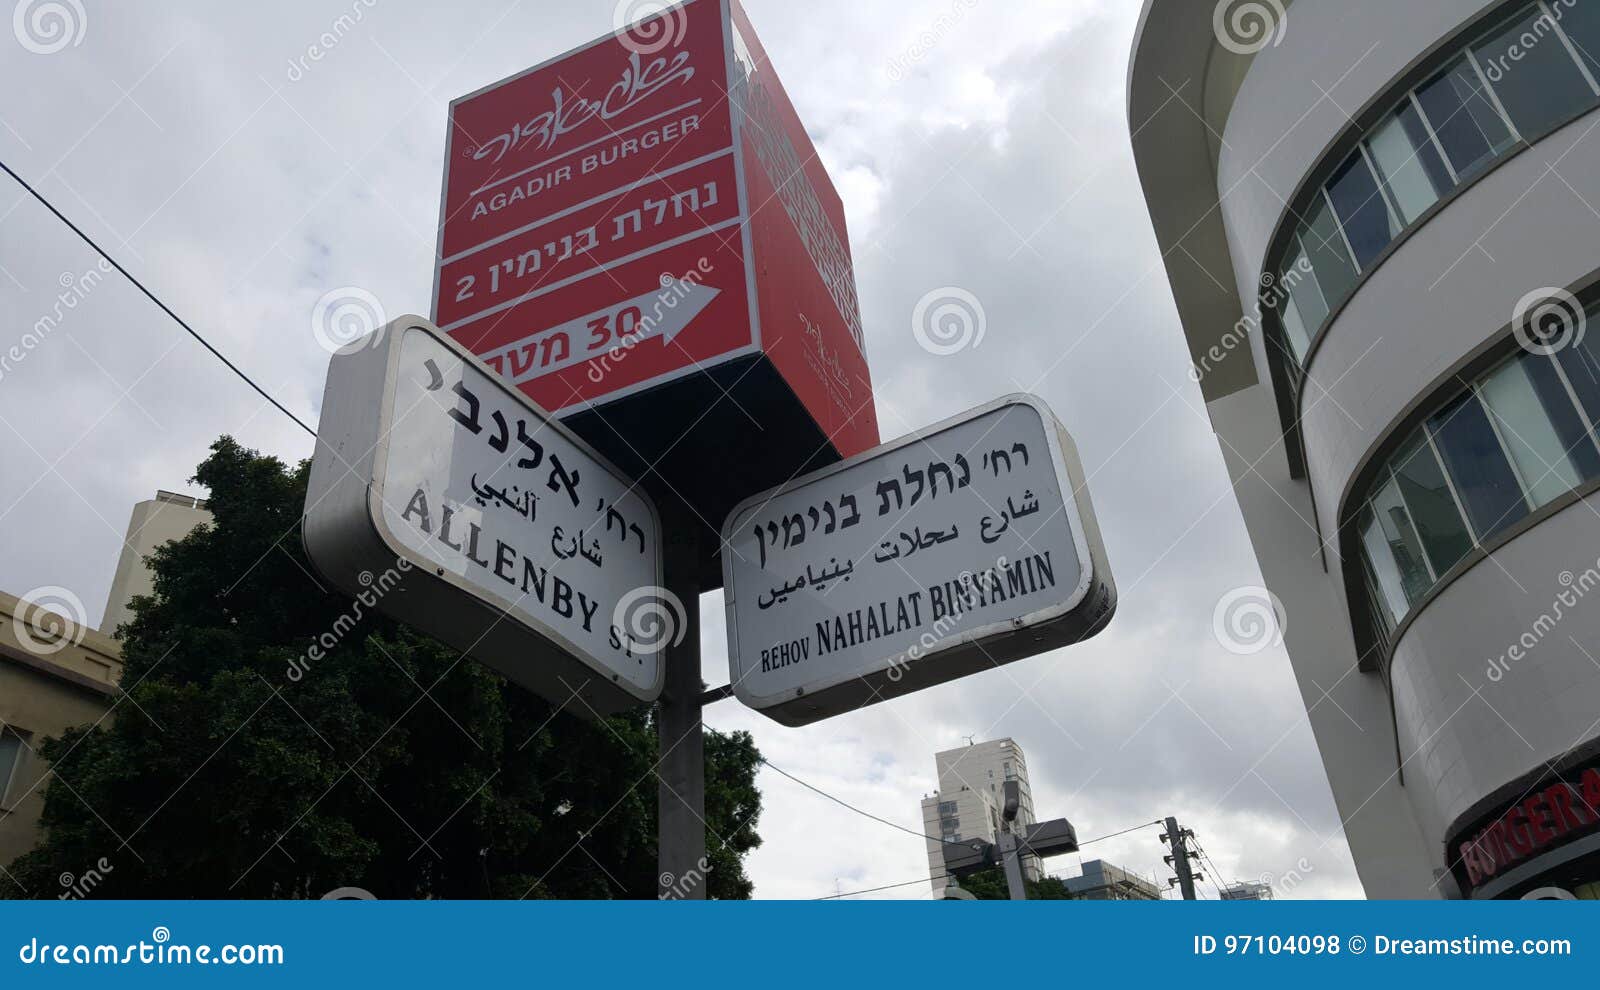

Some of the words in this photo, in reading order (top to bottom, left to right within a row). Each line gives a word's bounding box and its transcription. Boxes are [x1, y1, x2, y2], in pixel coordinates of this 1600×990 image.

[472, 166, 571, 219] AGADIR
[581, 115, 700, 174] BURGER
[611, 181, 718, 240] נחלת
[456, 275, 475, 302] 2
[488, 225, 600, 293] בנימין
[587, 306, 642, 350] 30
[423, 359, 580, 508] אלנבי
[876, 453, 971, 516] נחלת
[980, 490, 1039, 544] شارع
[401, 488, 599, 633] ALLENBY
[552, 525, 603, 568] شارع
[753, 493, 861, 570] בנימין
[761, 637, 809, 673] REHOV
[816, 591, 922, 655] NAHALAT
[928, 551, 1056, 622] BINYAMIN
